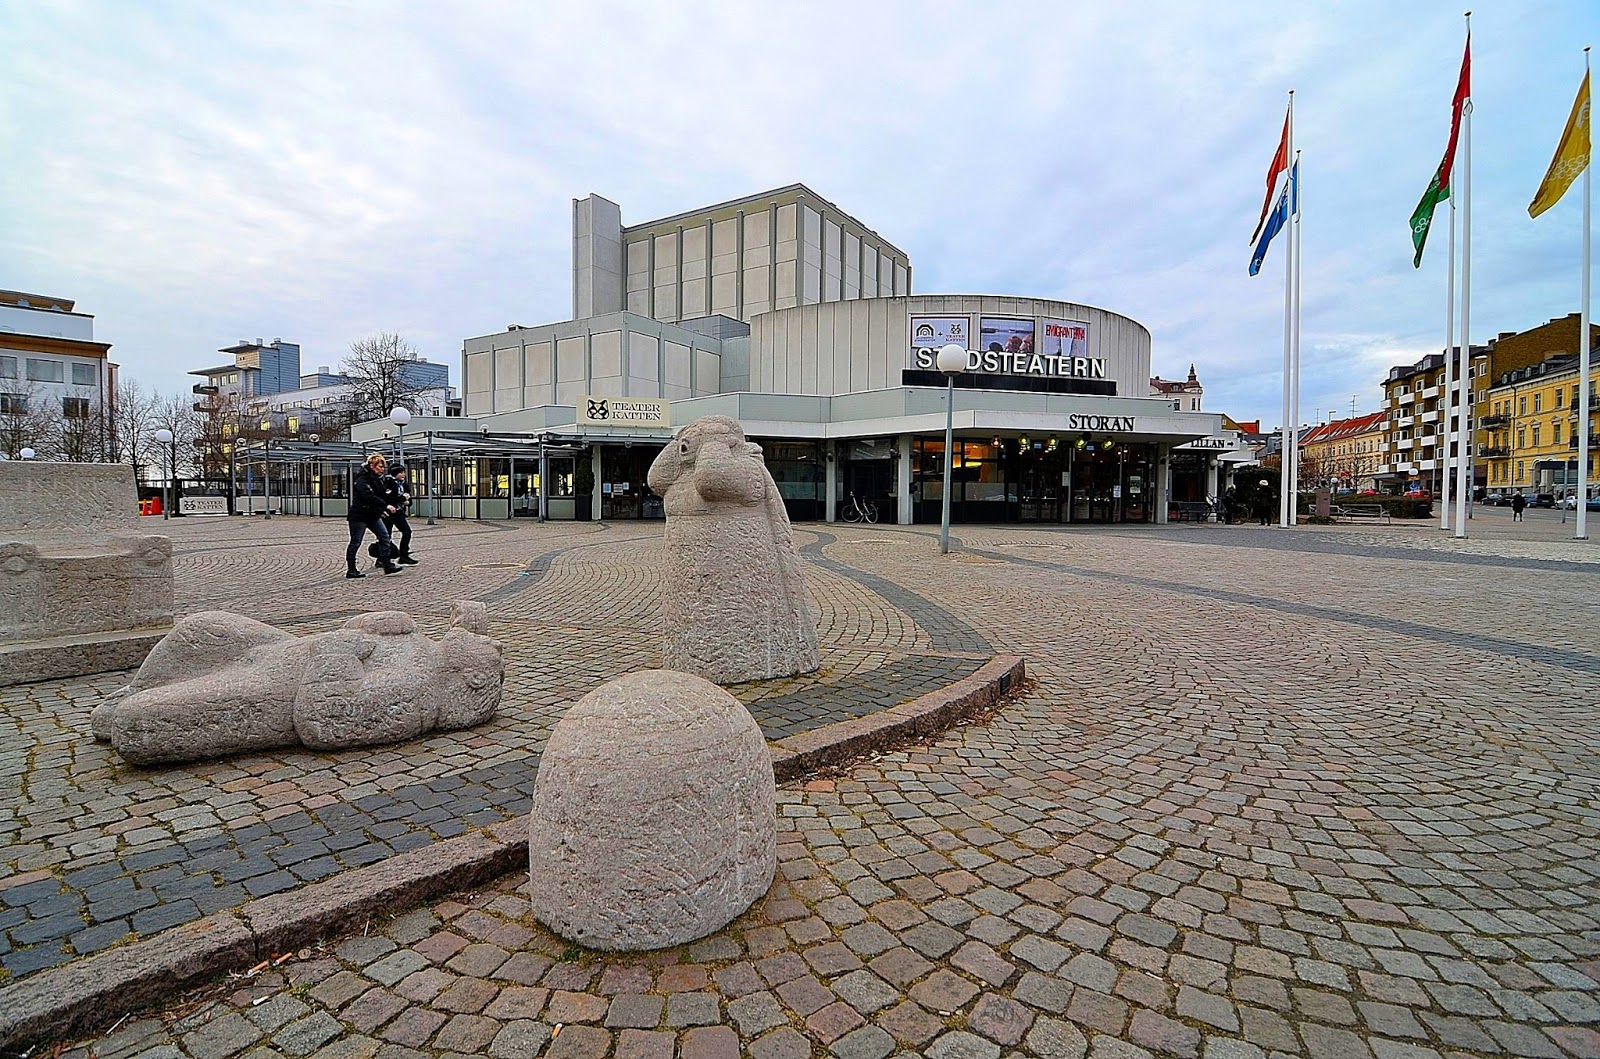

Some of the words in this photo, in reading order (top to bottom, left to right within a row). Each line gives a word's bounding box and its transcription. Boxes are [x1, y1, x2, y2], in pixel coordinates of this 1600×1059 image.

[917, 347, 1106, 378] SDSTEATERN
[612, 402, 660, 412] TEATER
[612, 411, 661, 420] KATTEN
[1069, 413, 1136, 432] STORAN
[1190, 439, 1225, 448] LILLAN
